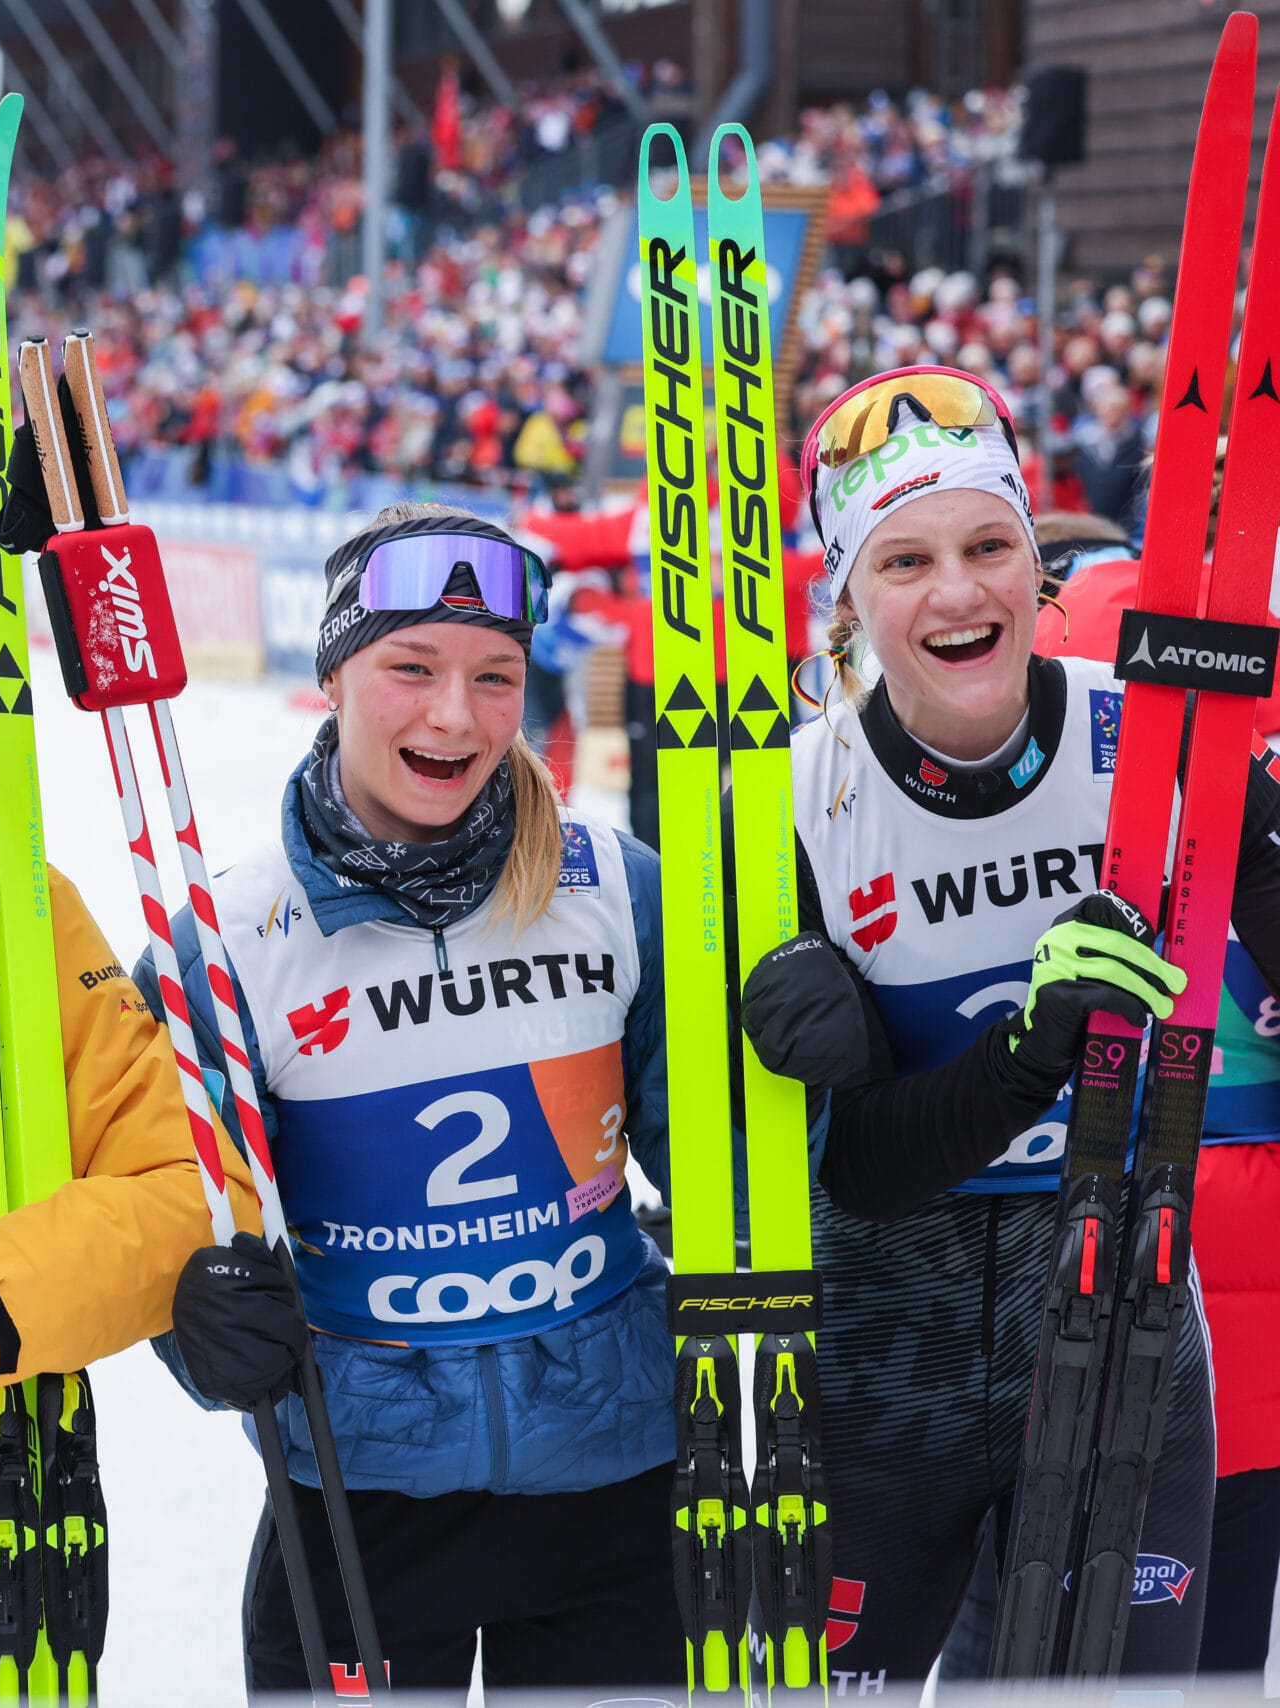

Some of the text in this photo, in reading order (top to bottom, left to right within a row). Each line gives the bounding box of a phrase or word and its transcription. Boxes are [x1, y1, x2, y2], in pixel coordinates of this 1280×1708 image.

[649, 237, 701, 643] FISCHER
[718, 238, 773, 644] FISCHER
[1157, 645, 1267, 676] ATOMIC
[904, 773, 957, 804] WÜRTH
[28, 820, 47, 918] SPEEDMAX
[700, 850, 718, 953] SPEEDMAX
[775, 850, 793, 942] PEEDMAX
[911, 843, 1106, 926] WÜRT
[365, 953, 615, 1032] WÜRTH
[1083, 1040, 1126, 1072] S9
[1157, 1069, 1196, 1081] CARBON
[1159, 1031, 1202, 1061] S9
[1081, 1078, 1120, 1090] CARBON
[413, 1090, 519, 1208] 2
[594, 1103, 623, 1163] 3
[322, 1200, 561, 1252] TRONDHEIM
[367, 1235, 606, 1324] coop
[678, 1294, 814, 1312] FISCHER
